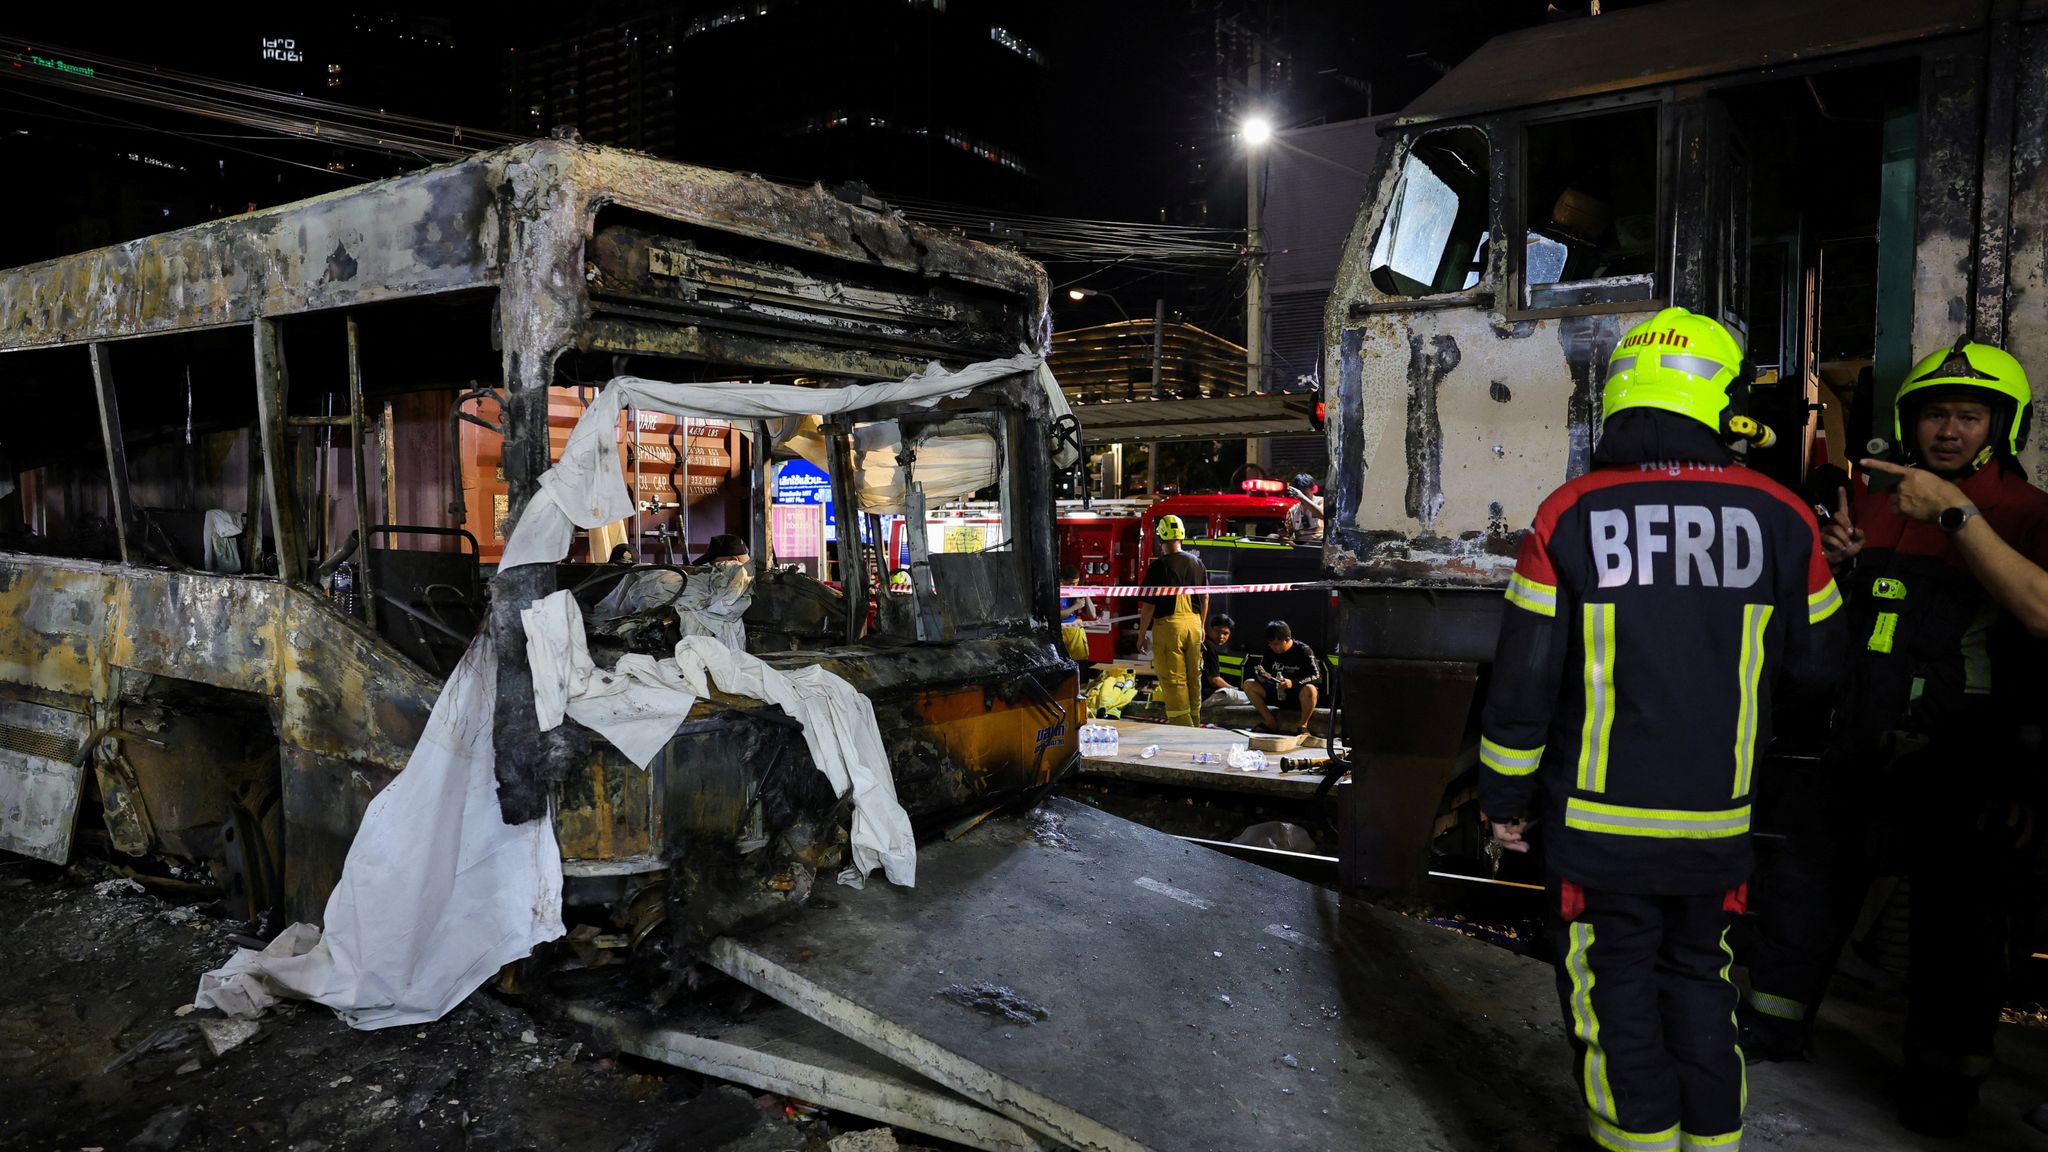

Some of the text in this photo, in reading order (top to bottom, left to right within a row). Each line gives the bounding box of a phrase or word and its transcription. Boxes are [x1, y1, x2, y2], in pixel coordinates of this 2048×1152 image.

[31, 55, 95, 77] Thai Summit
[639, 414, 658, 431] TARE
[639, 445, 672, 462] PAYLOAD
[1589, 504, 1764, 589] BFRD
